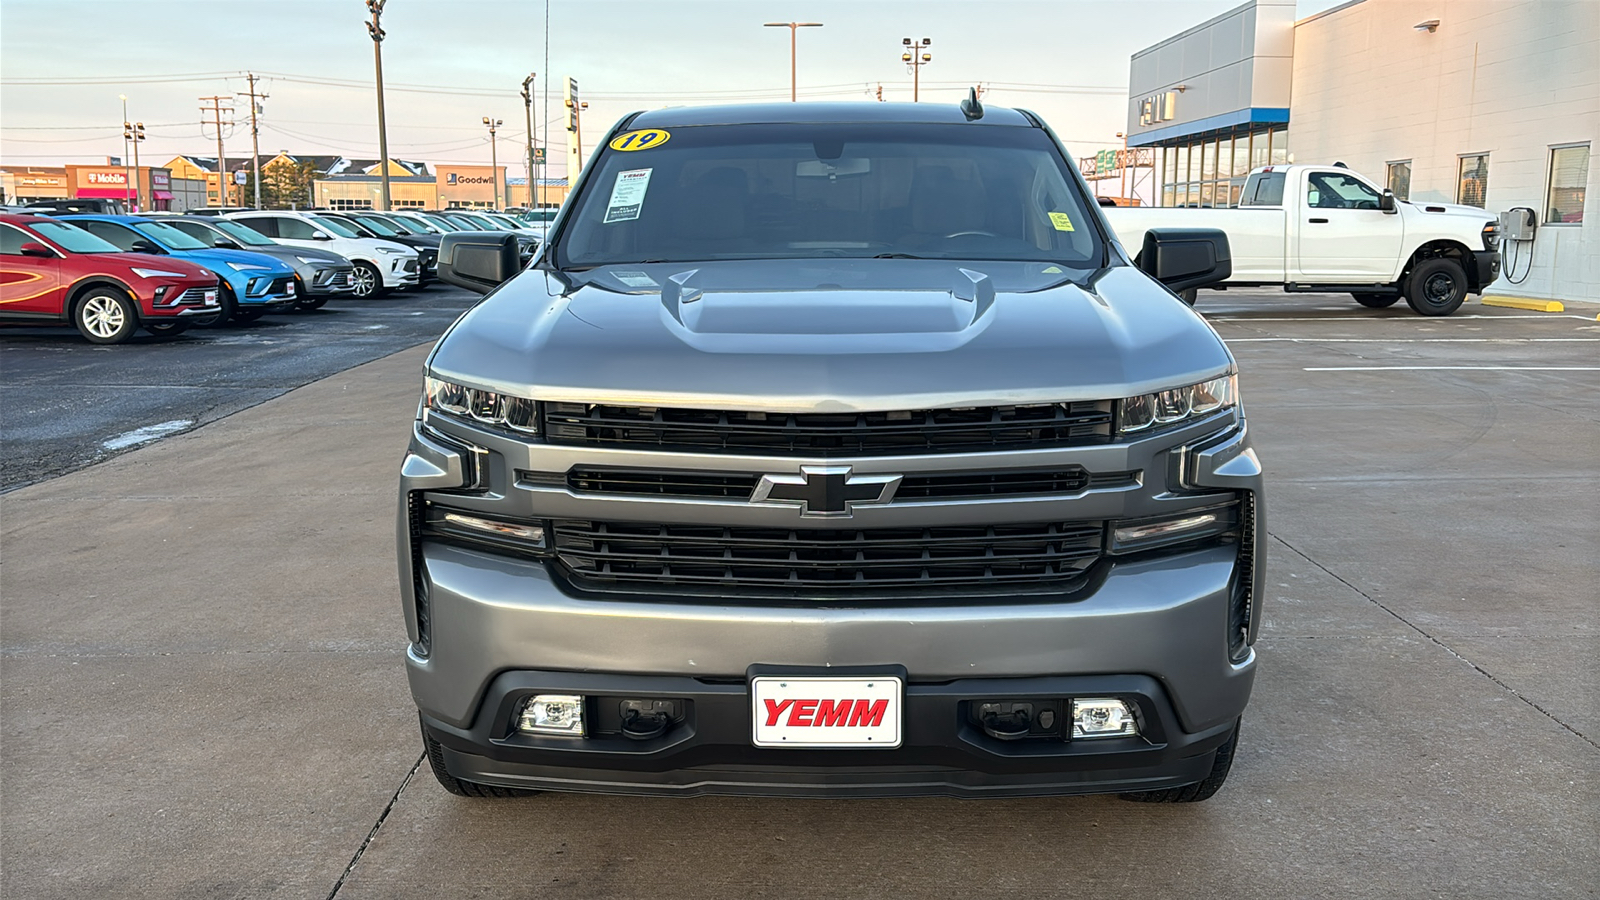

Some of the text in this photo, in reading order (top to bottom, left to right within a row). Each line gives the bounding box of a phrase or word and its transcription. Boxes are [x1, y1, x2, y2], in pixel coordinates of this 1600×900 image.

[620, 132, 658, 149] 19
[97, 173, 125, 183] Mobile
[763, 699, 889, 727] YEMM
